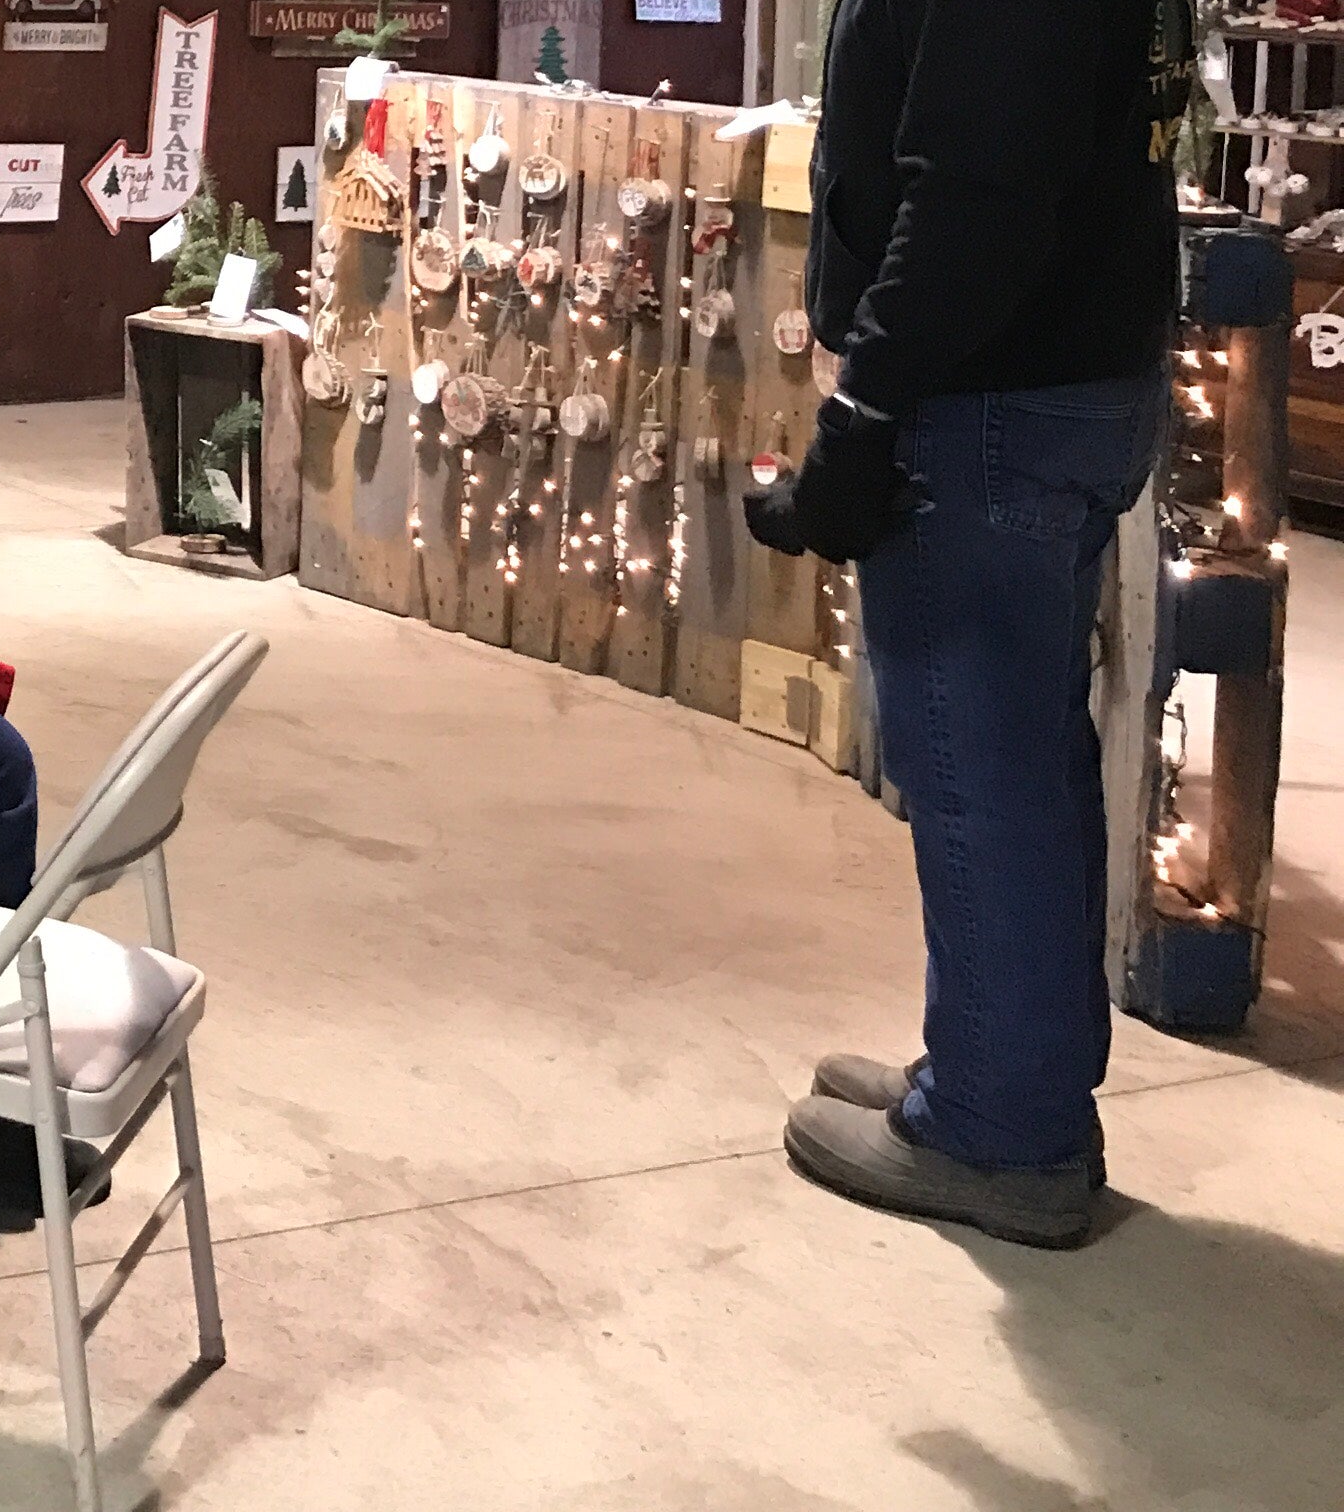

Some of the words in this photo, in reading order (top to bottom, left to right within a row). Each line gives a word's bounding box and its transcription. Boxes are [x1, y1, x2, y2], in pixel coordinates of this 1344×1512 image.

[274, 8, 337, 31] MERRY
[21, 29, 52, 45] MERRY
[170, 31, 200, 109] TREE
[161, 114, 191, 192] FARM
[7, 158, 41, 172] CUT
[120, 163, 154, 186] Fresh
[0, 186, 43, 218] Trees
